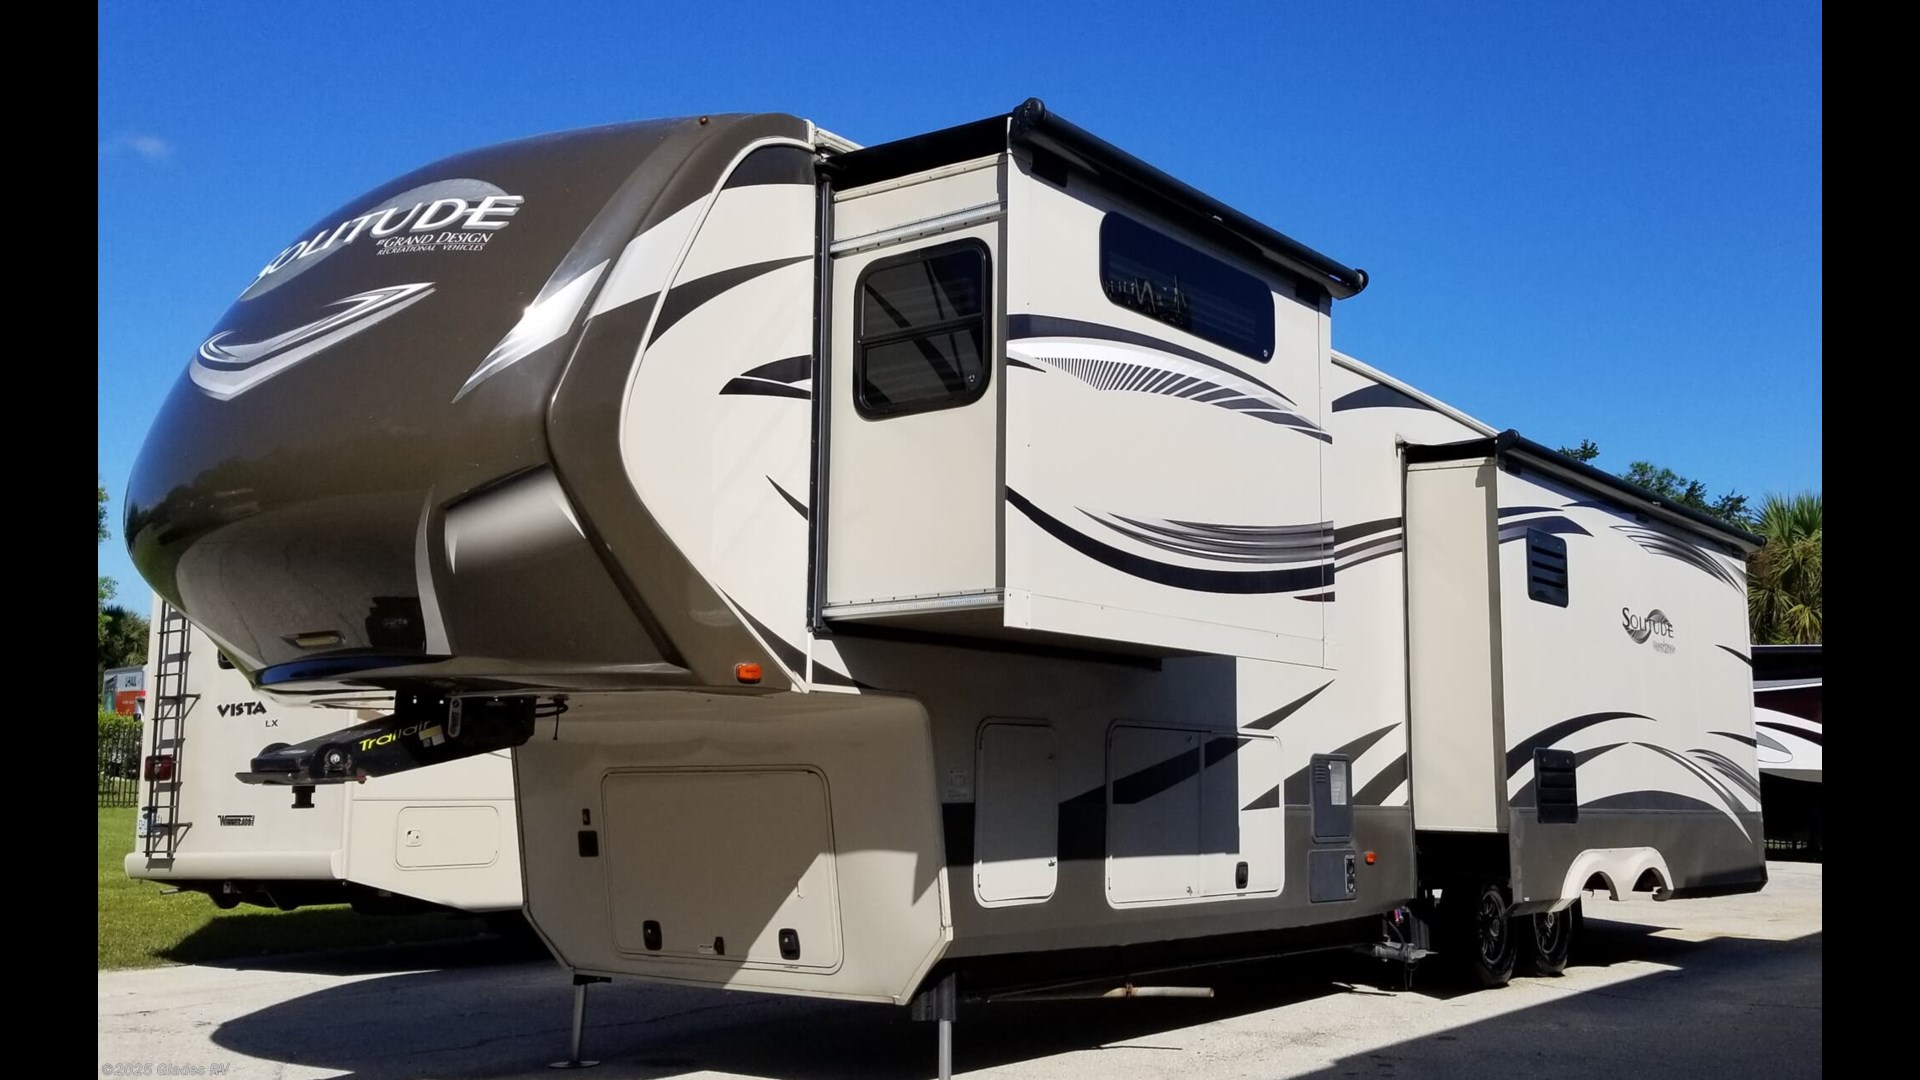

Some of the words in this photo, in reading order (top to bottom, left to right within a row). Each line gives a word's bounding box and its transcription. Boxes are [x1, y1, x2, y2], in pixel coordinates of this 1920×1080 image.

[238, 195, 525, 300] SOLITUDE
[384, 234, 434, 249] GRAND
[436, 231, 494, 244] DESIGN
[376, 244, 436, 256] RECREATIONAL
[442, 243, 484, 251] VEHICLES
[1622, 607, 1675, 639] SOLITUDE
[217, 701, 267, 718] VISTA
[265, 719, 279, 728] LX
